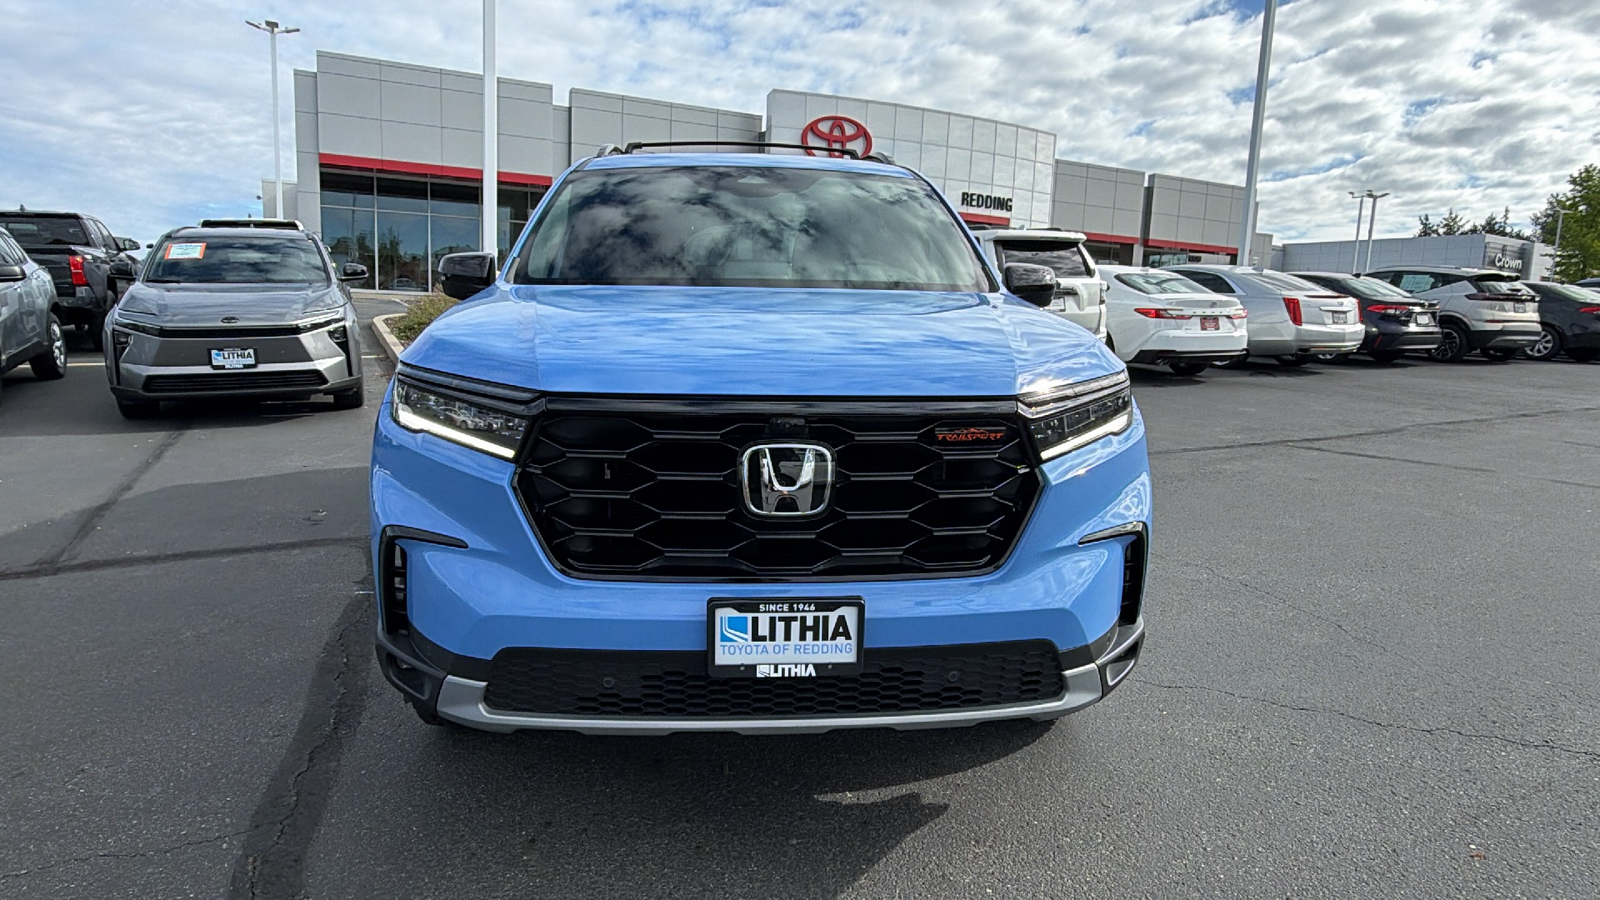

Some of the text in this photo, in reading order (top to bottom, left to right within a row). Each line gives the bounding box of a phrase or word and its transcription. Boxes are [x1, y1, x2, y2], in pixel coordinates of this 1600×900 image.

[961, 191, 1012, 212] REDDING
[1495, 253, 1522, 270] Crown
[222, 351, 253, 360] LITHIA
[936, 432, 1004, 442] TRAILSPORT
[759, 603, 816, 612] SINCE 1946
[751, 615, 852, 642] LITHIA
[720, 643, 853, 655] TOYOTA OF REDDING
[770, 664, 816, 677] LITHIA
